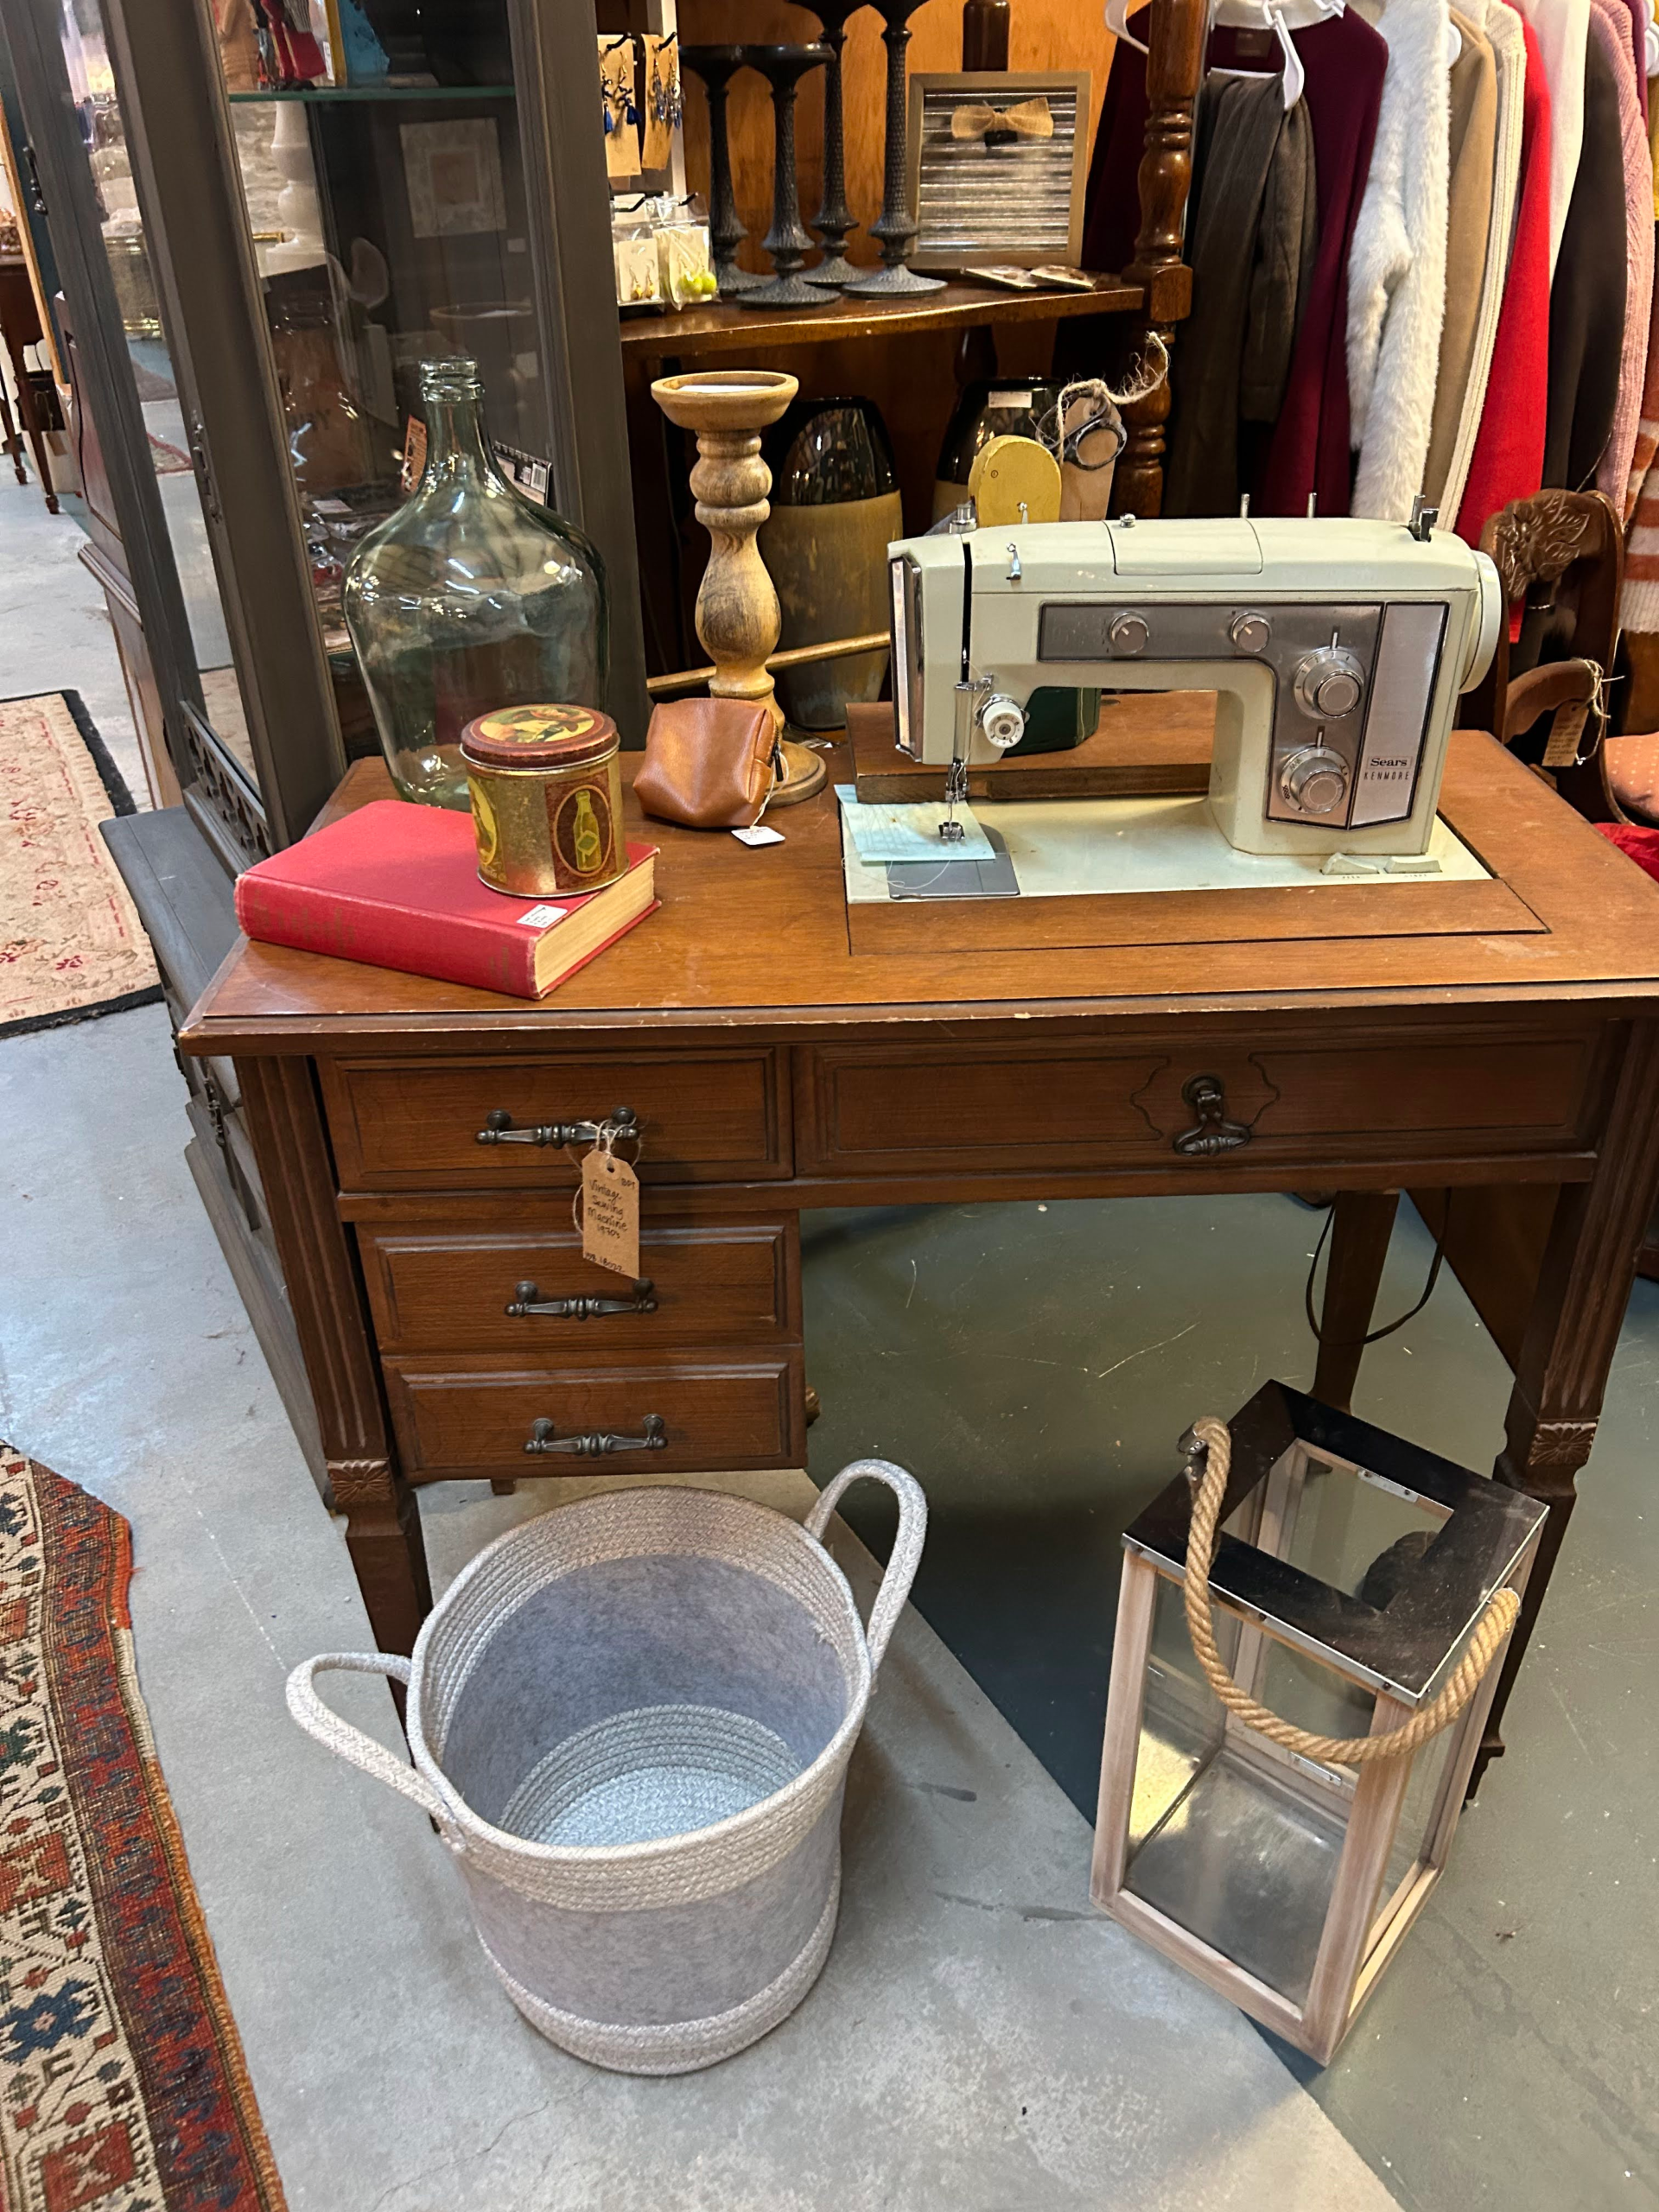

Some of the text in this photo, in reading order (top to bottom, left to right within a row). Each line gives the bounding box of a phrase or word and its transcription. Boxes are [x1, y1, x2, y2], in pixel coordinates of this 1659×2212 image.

[1370, 757, 1408, 767] Sears
[1363, 771, 1410, 781] KENMORE
[591, 1194, 624, 1220] Sewing
